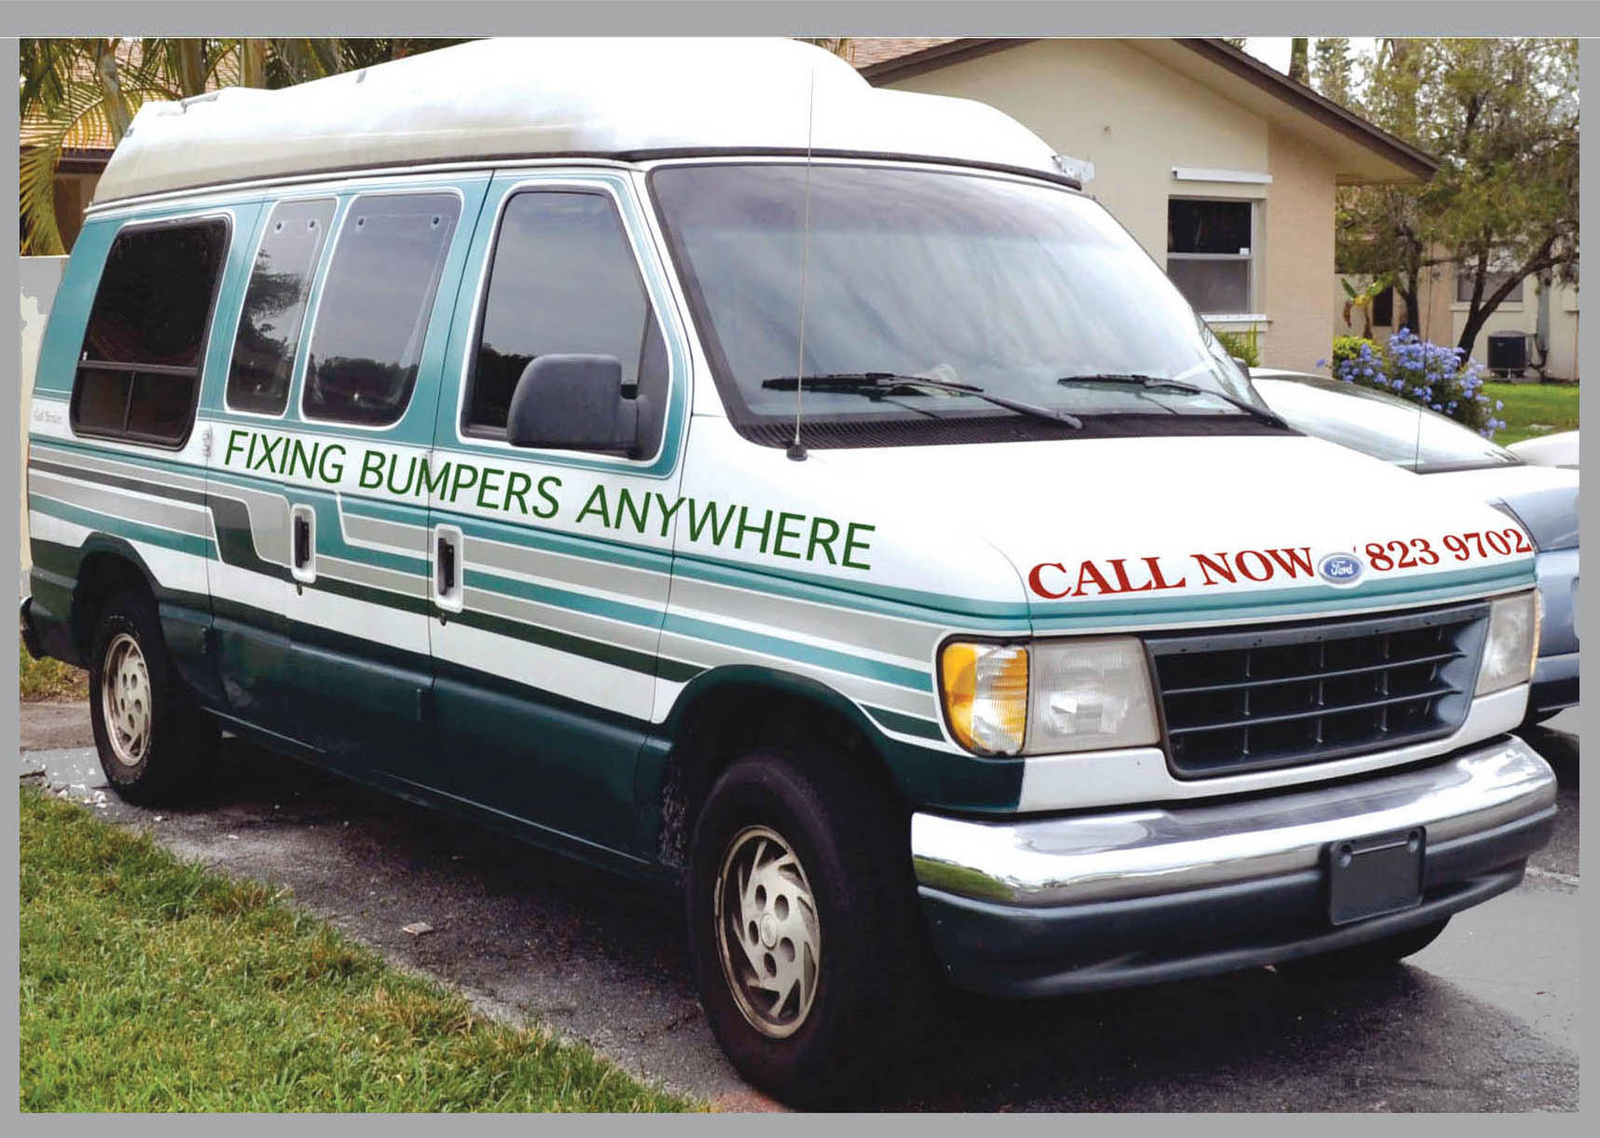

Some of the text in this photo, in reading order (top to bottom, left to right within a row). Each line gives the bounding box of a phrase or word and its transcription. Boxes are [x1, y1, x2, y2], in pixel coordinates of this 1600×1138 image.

[224, 430, 876, 570] FIXING BUMPERS ANYWHERE
[1028, 555, 1186, 600] CALL
[1191, 547, 1315, 587] NOW
[1442, 528, 1533, 561] 9702
[1330, 561, 1354, 576] Ford
